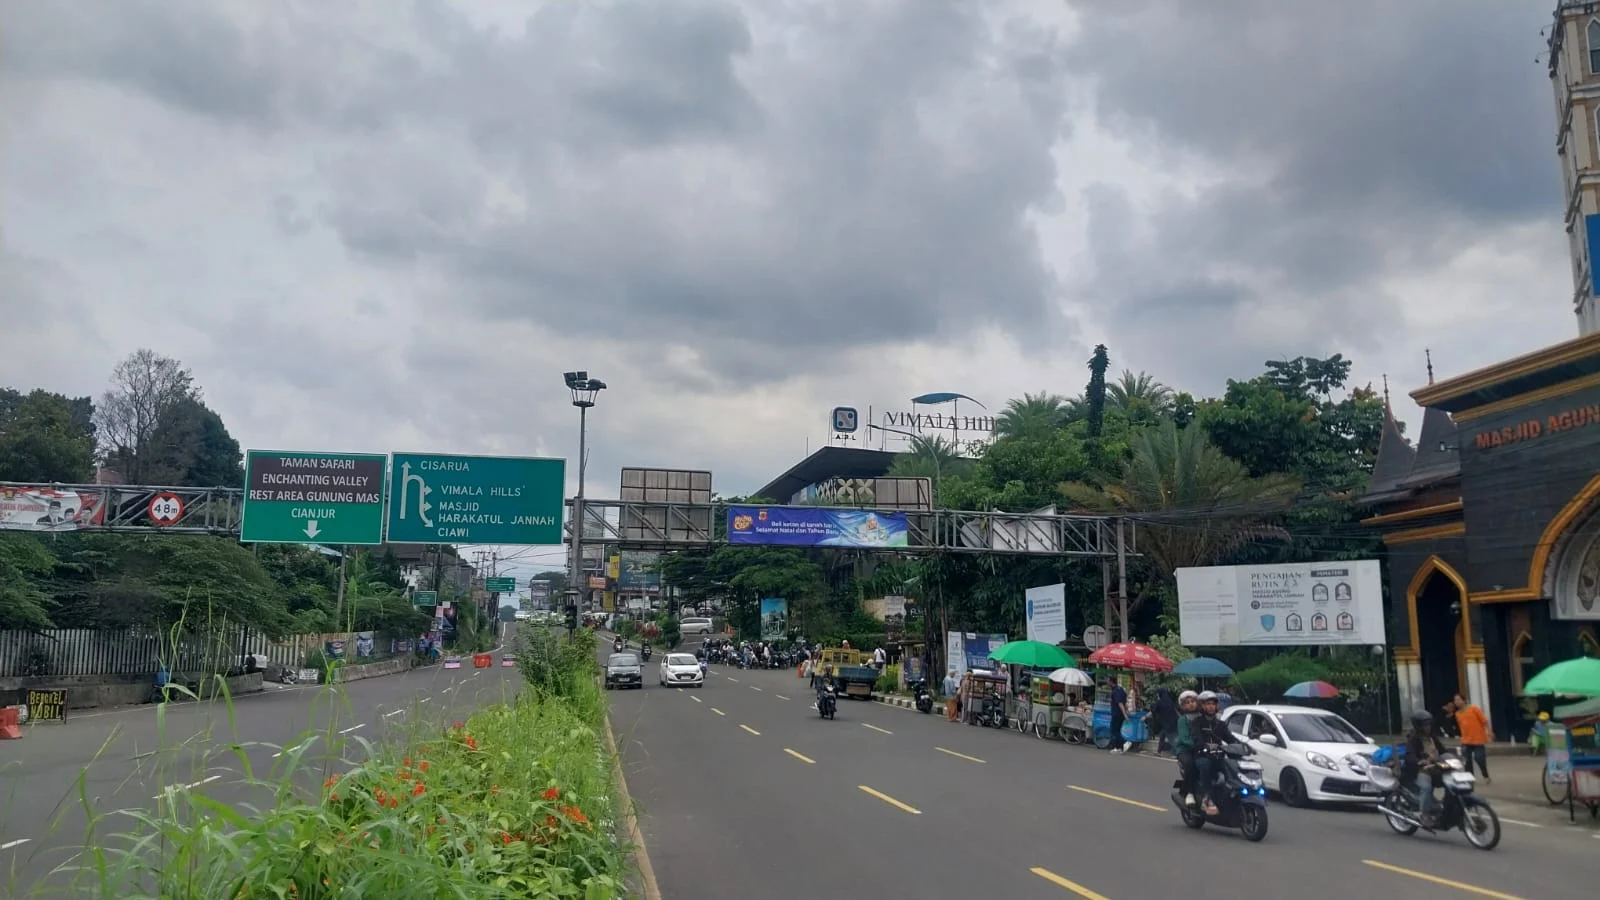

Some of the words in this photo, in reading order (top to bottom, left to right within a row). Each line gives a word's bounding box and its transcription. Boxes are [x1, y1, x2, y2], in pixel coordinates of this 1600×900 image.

[886, 411, 958, 433] VIMALA
[963, 416, 994, 431] HILL
[1476, 420, 1542, 448] MASJID
[1547, 404, 1600, 433] AGUN
[280, 457, 318, 469] TAMAN
[320, 458, 355, 470] SAFARI
[420, 460, 470, 472] CISARUA
[262, 473, 330, 486] ENCHANTING
[332, 475, 369, 487] VALLEY
[249, 489, 274, 500] REST
[276, 490, 304, 501] AREA
[306, 491, 353, 503] GUNUNG
[355, 493, 380, 504] MAS
[441, 485, 483, 496] VIMALA
[291, 507, 336, 519] CIANJUR
[439, 502, 480, 512] MASJID
[438, 513, 504, 525] HARAKATUL
[510, 515, 555, 526] JANNAH
[437, 527, 469, 537] CIAWI
[1251, 572, 1302, 580] PENGAJIAN
[1251, 580, 1279, 588] RUTIN
